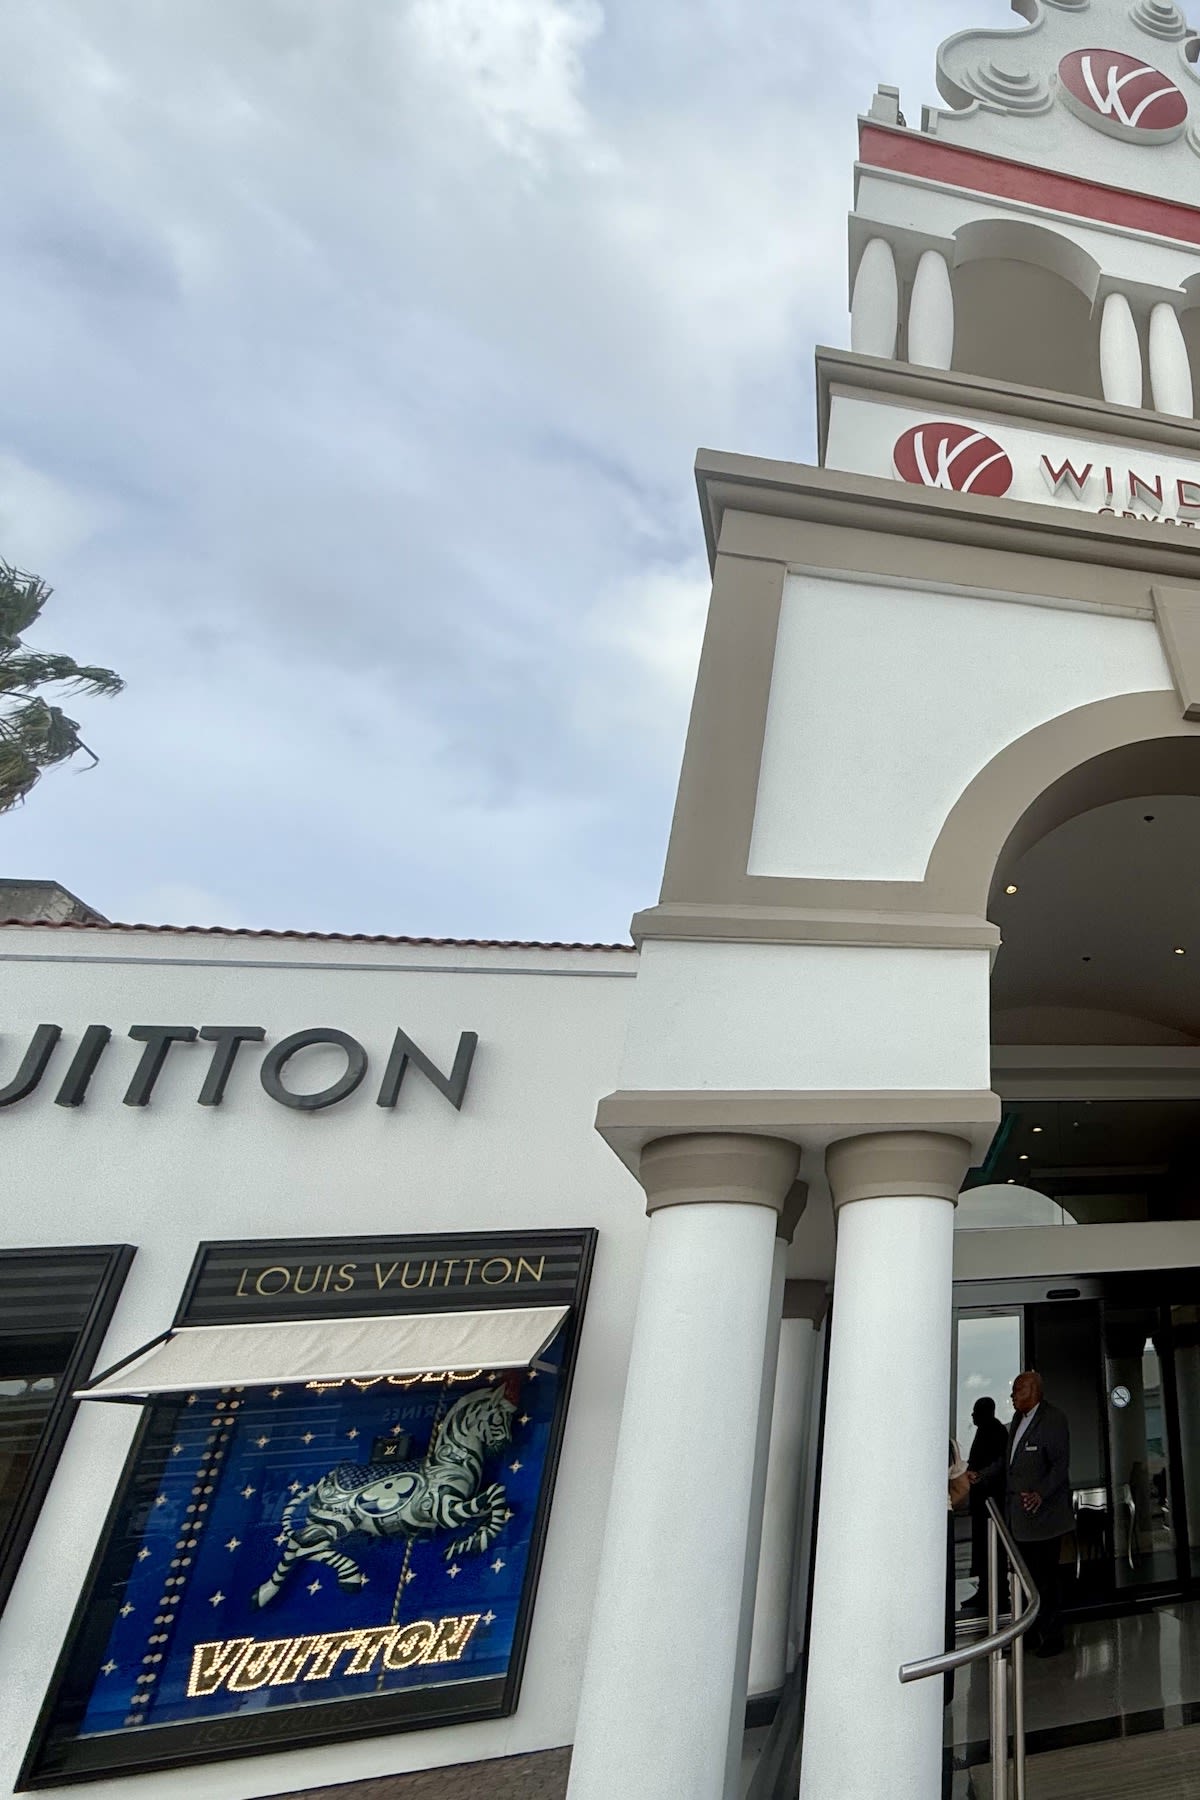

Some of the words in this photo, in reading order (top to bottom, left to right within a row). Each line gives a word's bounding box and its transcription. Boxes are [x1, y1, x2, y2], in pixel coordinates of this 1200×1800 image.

[236, 1263, 357, 1297] LOUIS
[375, 1256, 545, 1290] VUITTON
[186, 1614, 481, 1697] VUITTON
